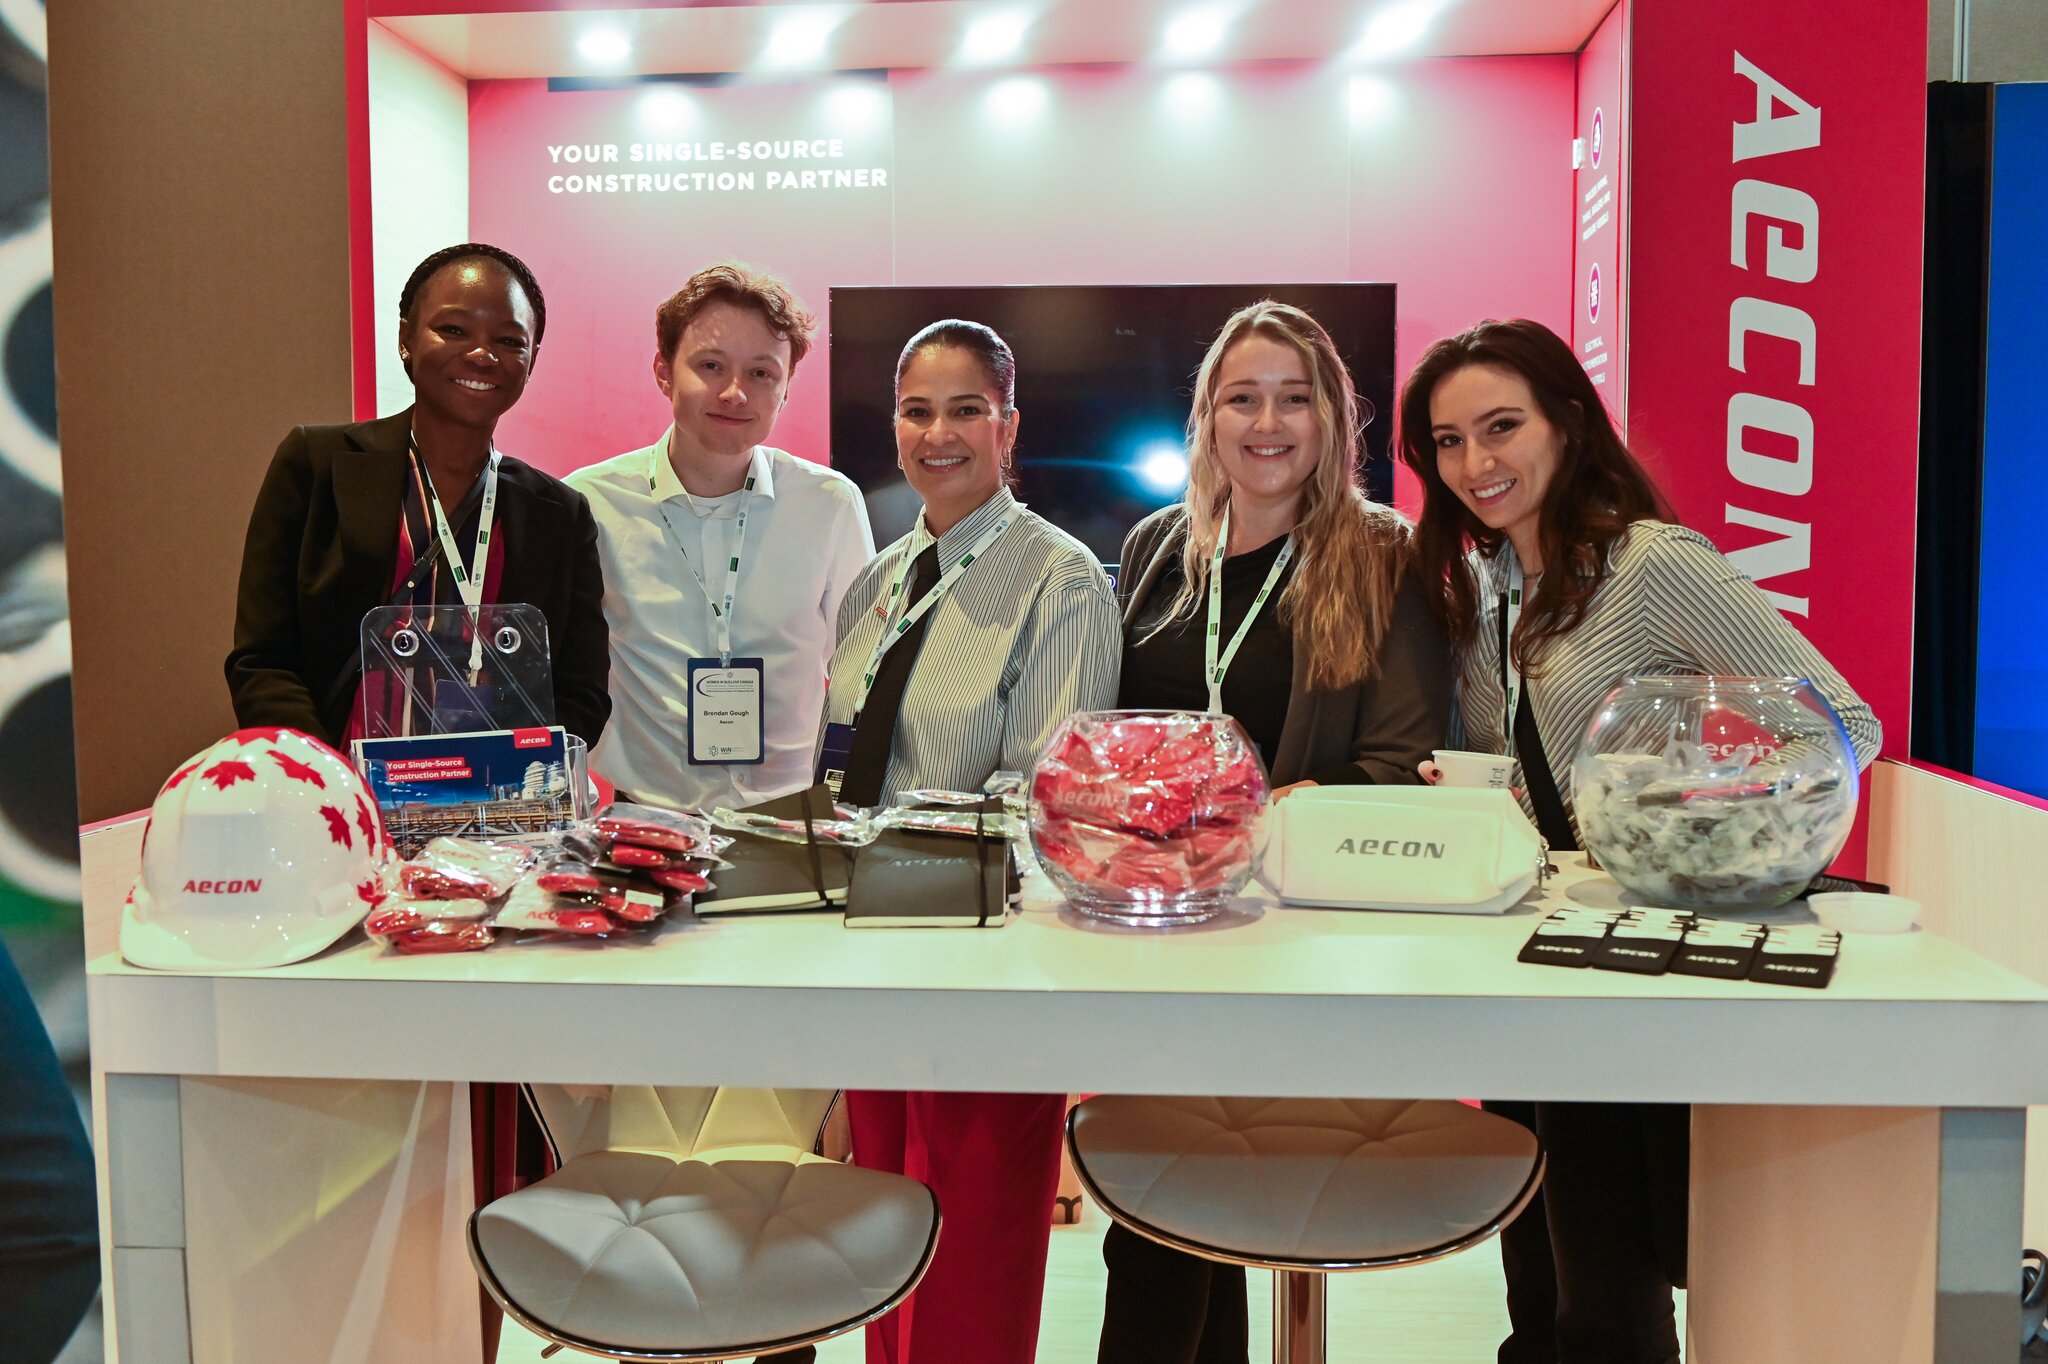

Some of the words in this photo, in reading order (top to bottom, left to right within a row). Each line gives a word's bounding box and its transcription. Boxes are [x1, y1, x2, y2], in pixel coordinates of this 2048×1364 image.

[547, 144, 618, 164] YOUR
[629, 139, 844, 162] SINGLE-SOURCE
[547, 172, 755, 194] CONSTRUCTION
[766, 168, 888, 190] PARTNER
[386, 761, 406, 770] Your
[408, 759, 463, 770] Single-Source
[388, 771, 439, 781] Construction
[441, 769, 470, 779] Partner
